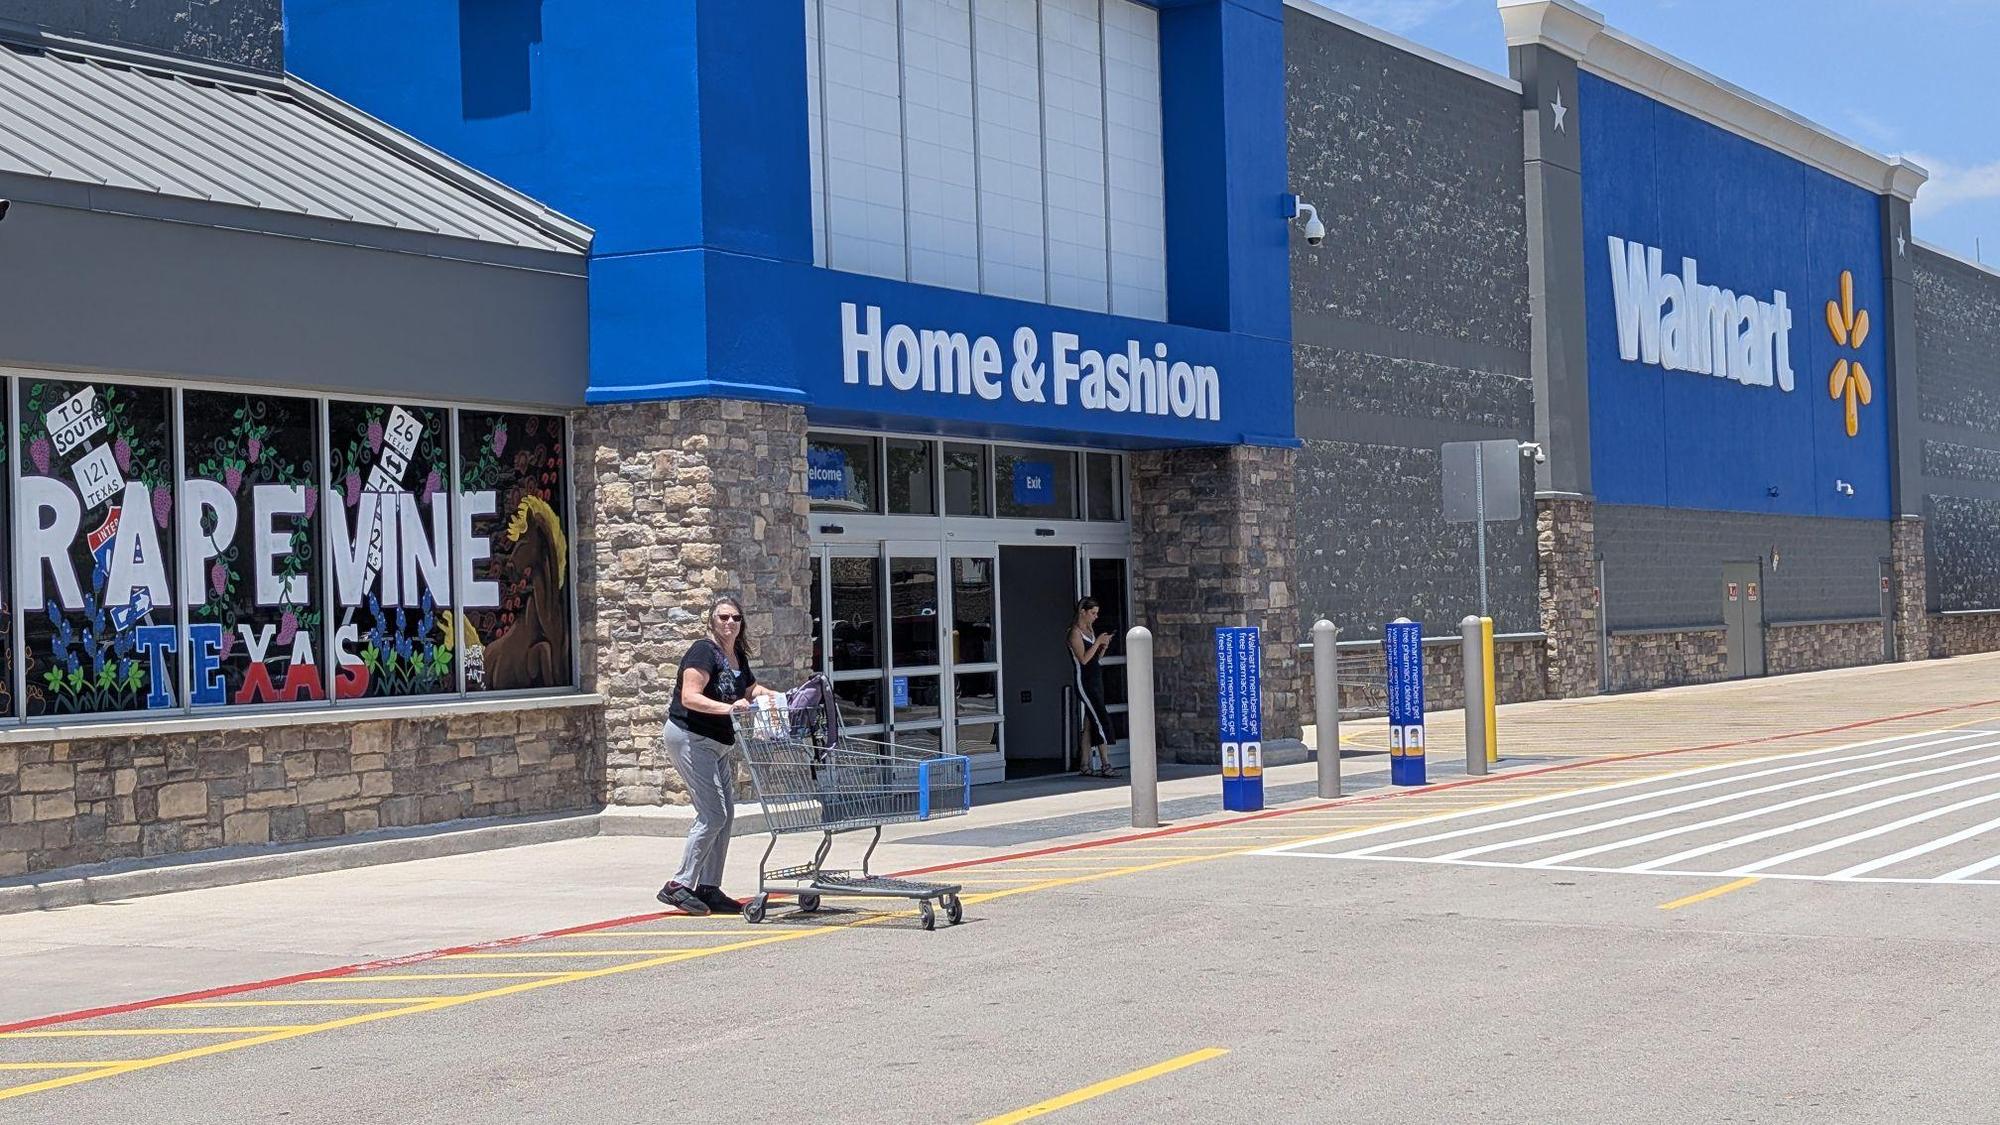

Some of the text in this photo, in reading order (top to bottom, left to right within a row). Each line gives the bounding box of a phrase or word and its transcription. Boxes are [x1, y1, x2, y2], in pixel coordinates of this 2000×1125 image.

[1607, 236, 1795, 392] Walmart
[841, 302, 1221, 421] Home & Fashion
[58, 398, 83, 422] TO
[393, 414, 414, 442] 26
[56, 413, 102, 453] SOUTH
[388, 433, 409, 455] TEXAS
[83, 458, 108, 487] 121
[808, 466, 842, 481] elcome
[1026, 475, 1042, 490] Exit
[87, 479, 119, 505] TEXAS
[20, 474, 500, 608] RAPEVINE
[136, 623, 370, 709] TEXAS
[466, 668, 486, 683] ART
[1218, 652, 1226, 696] pharmacy
[1238, 651, 1247, 696] pharmacy
[1402, 644, 1410, 684] pharmacy
[1227, 676, 1236, 719] members
[1248, 632, 1258, 736] Walmart+ members get
[1412, 665, 1420, 705] members
[1220, 697, 1228, 733] delivery
[1228, 720, 1236, 736] get
[1241, 697, 1249, 733] delivery
[1412, 705, 1420, 719] get
